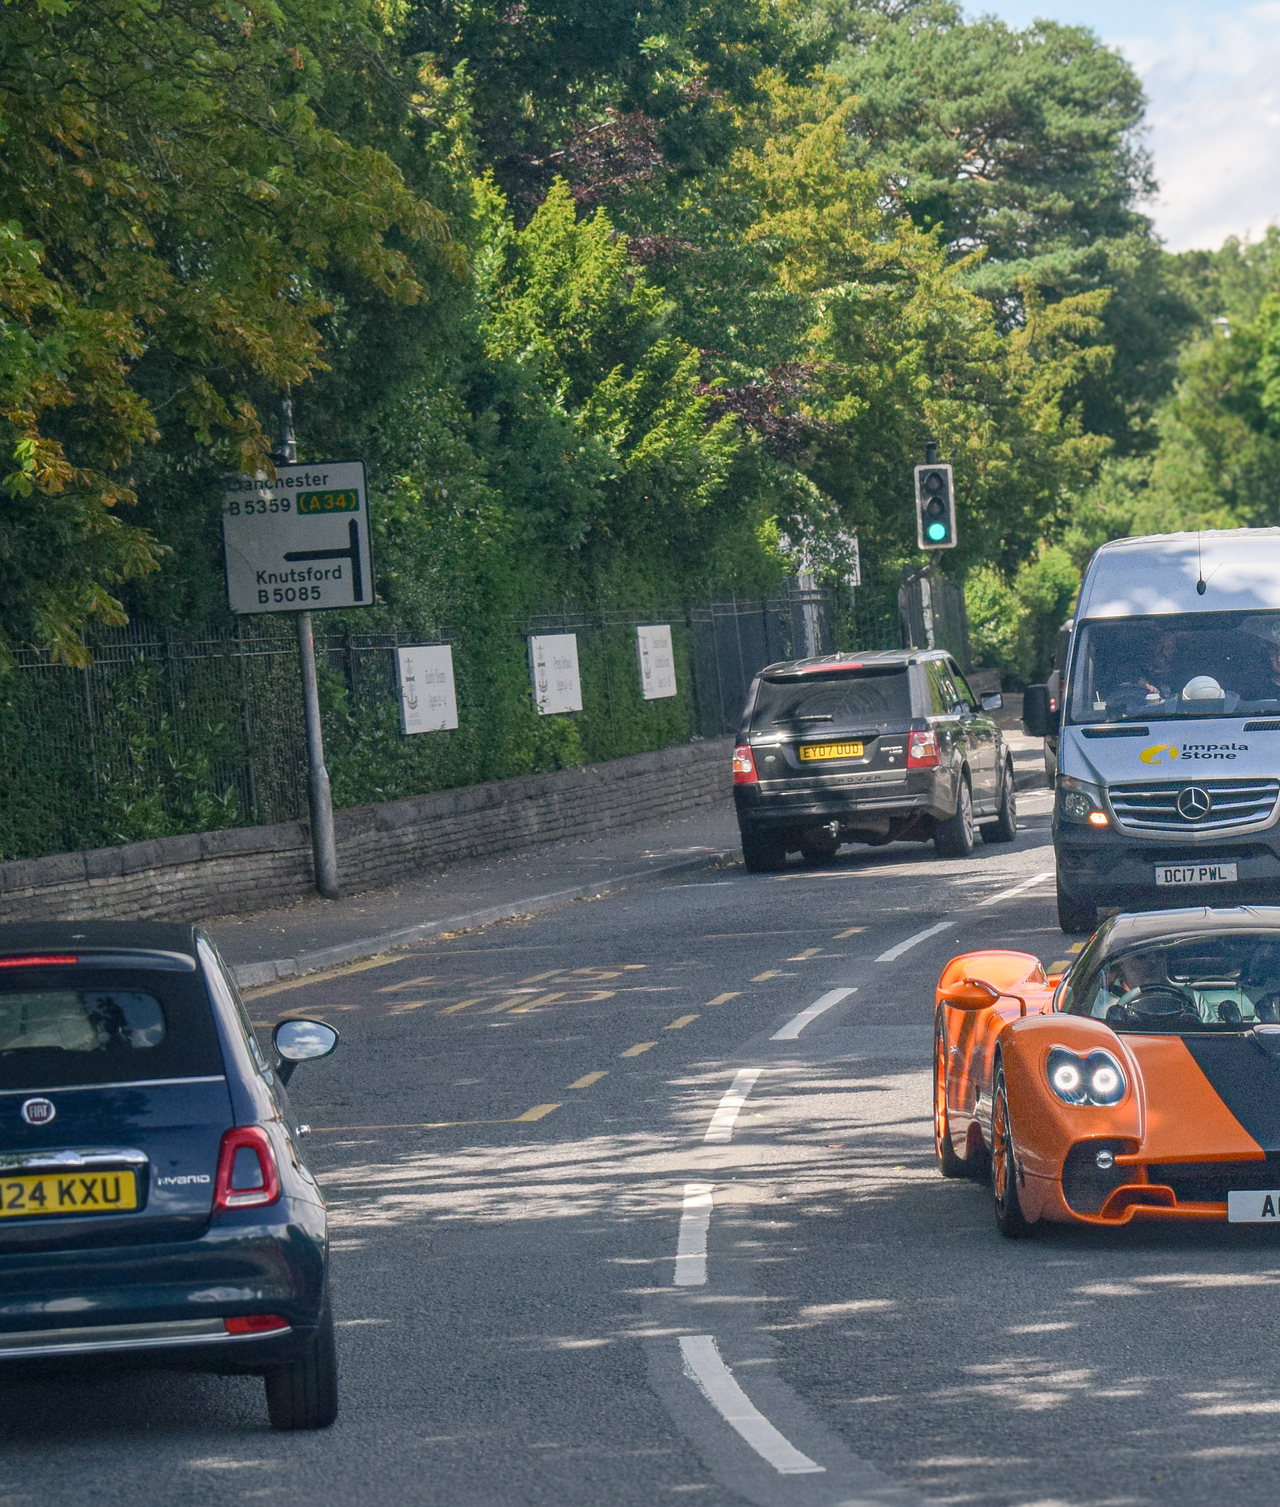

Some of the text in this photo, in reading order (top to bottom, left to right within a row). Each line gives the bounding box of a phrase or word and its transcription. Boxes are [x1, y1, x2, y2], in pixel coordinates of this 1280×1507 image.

[231, 472, 329, 490] anchester
[256, 565, 342, 585] Knutsford
[803, 744, 859, 758] EY07 UUD
[1182, 742, 1249, 752] Impala
[1181, 751, 1237, 760] Stone
[1164, 867, 1227, 883] DC17 PWL
[28, 1104, 48, 1118] FIAT
[157, 1174, 211, 1186] HYBRID
[0, 1178, 121, 1210] 24 KXU
